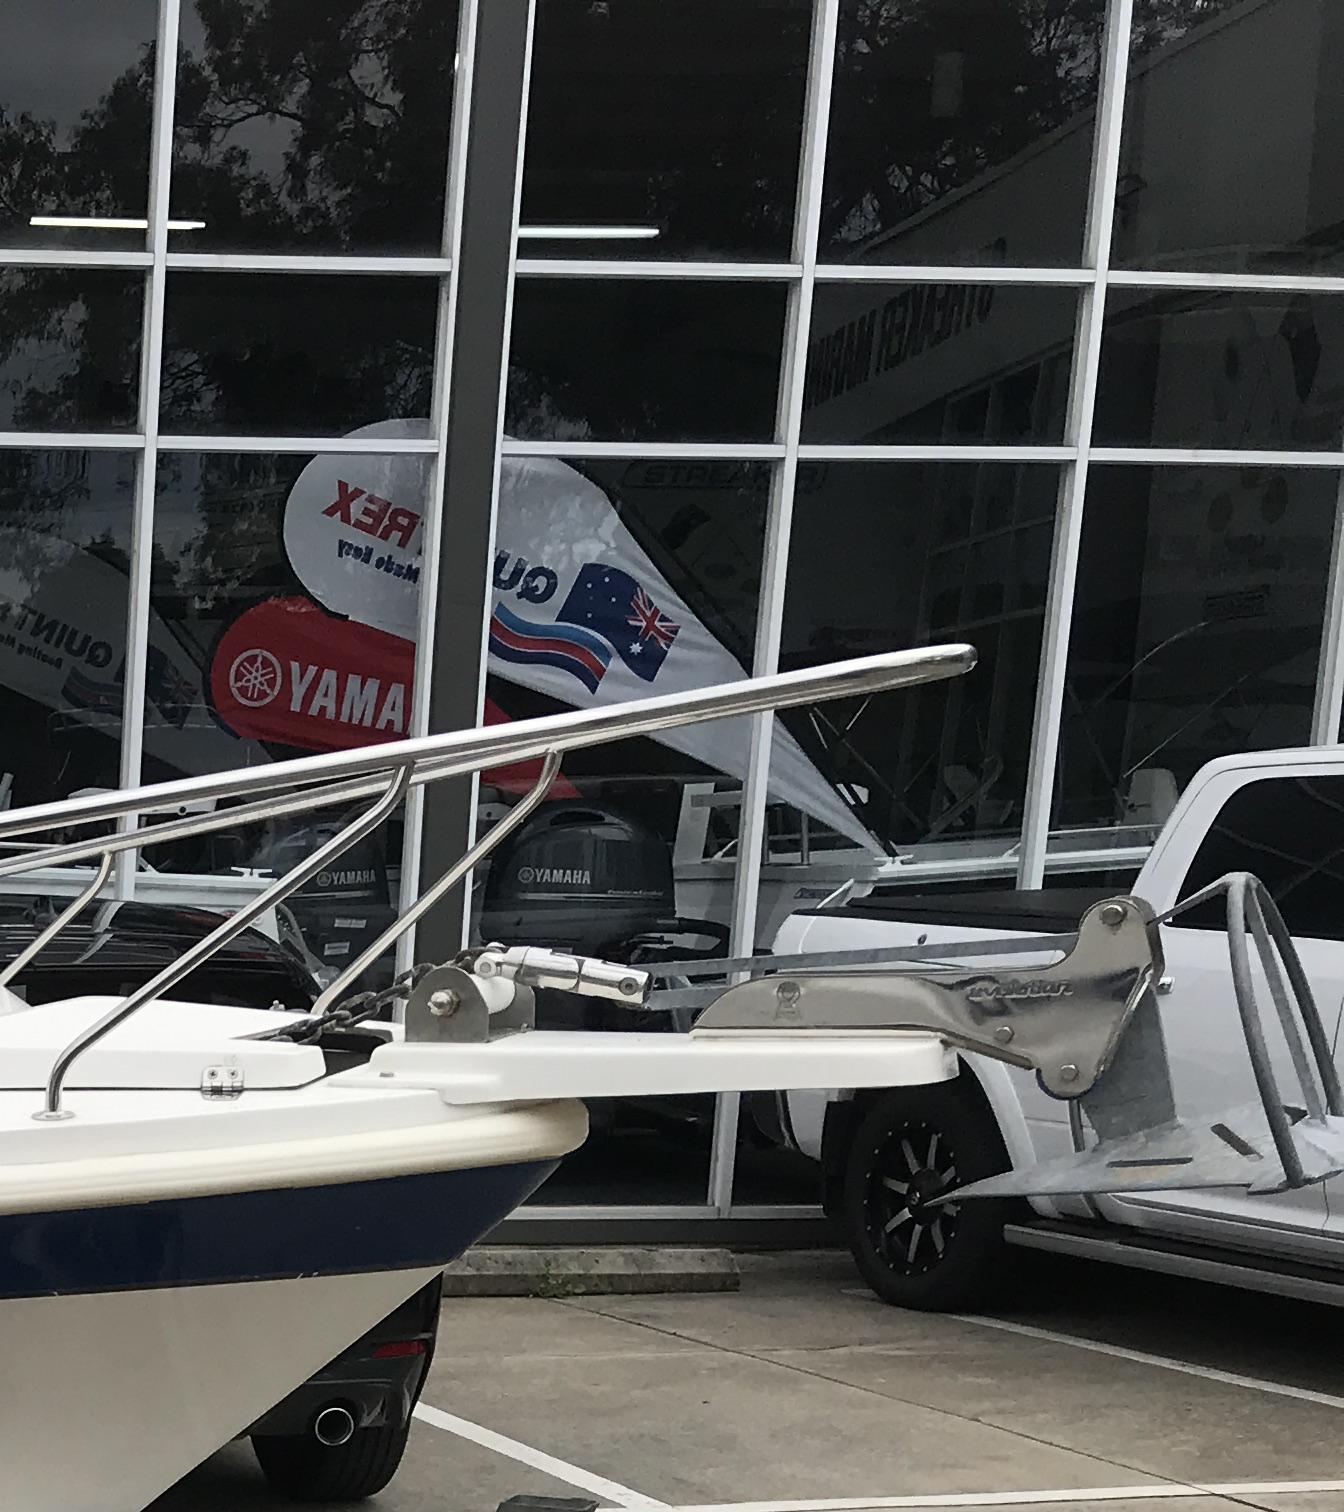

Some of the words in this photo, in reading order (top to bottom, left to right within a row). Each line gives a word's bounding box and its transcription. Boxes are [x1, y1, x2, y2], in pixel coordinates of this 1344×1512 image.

[289, 660, 413, 737] YAMA
[333, 870, 376, 885] YAMAHA
[536, 868, 591, 885] YAMAHA
